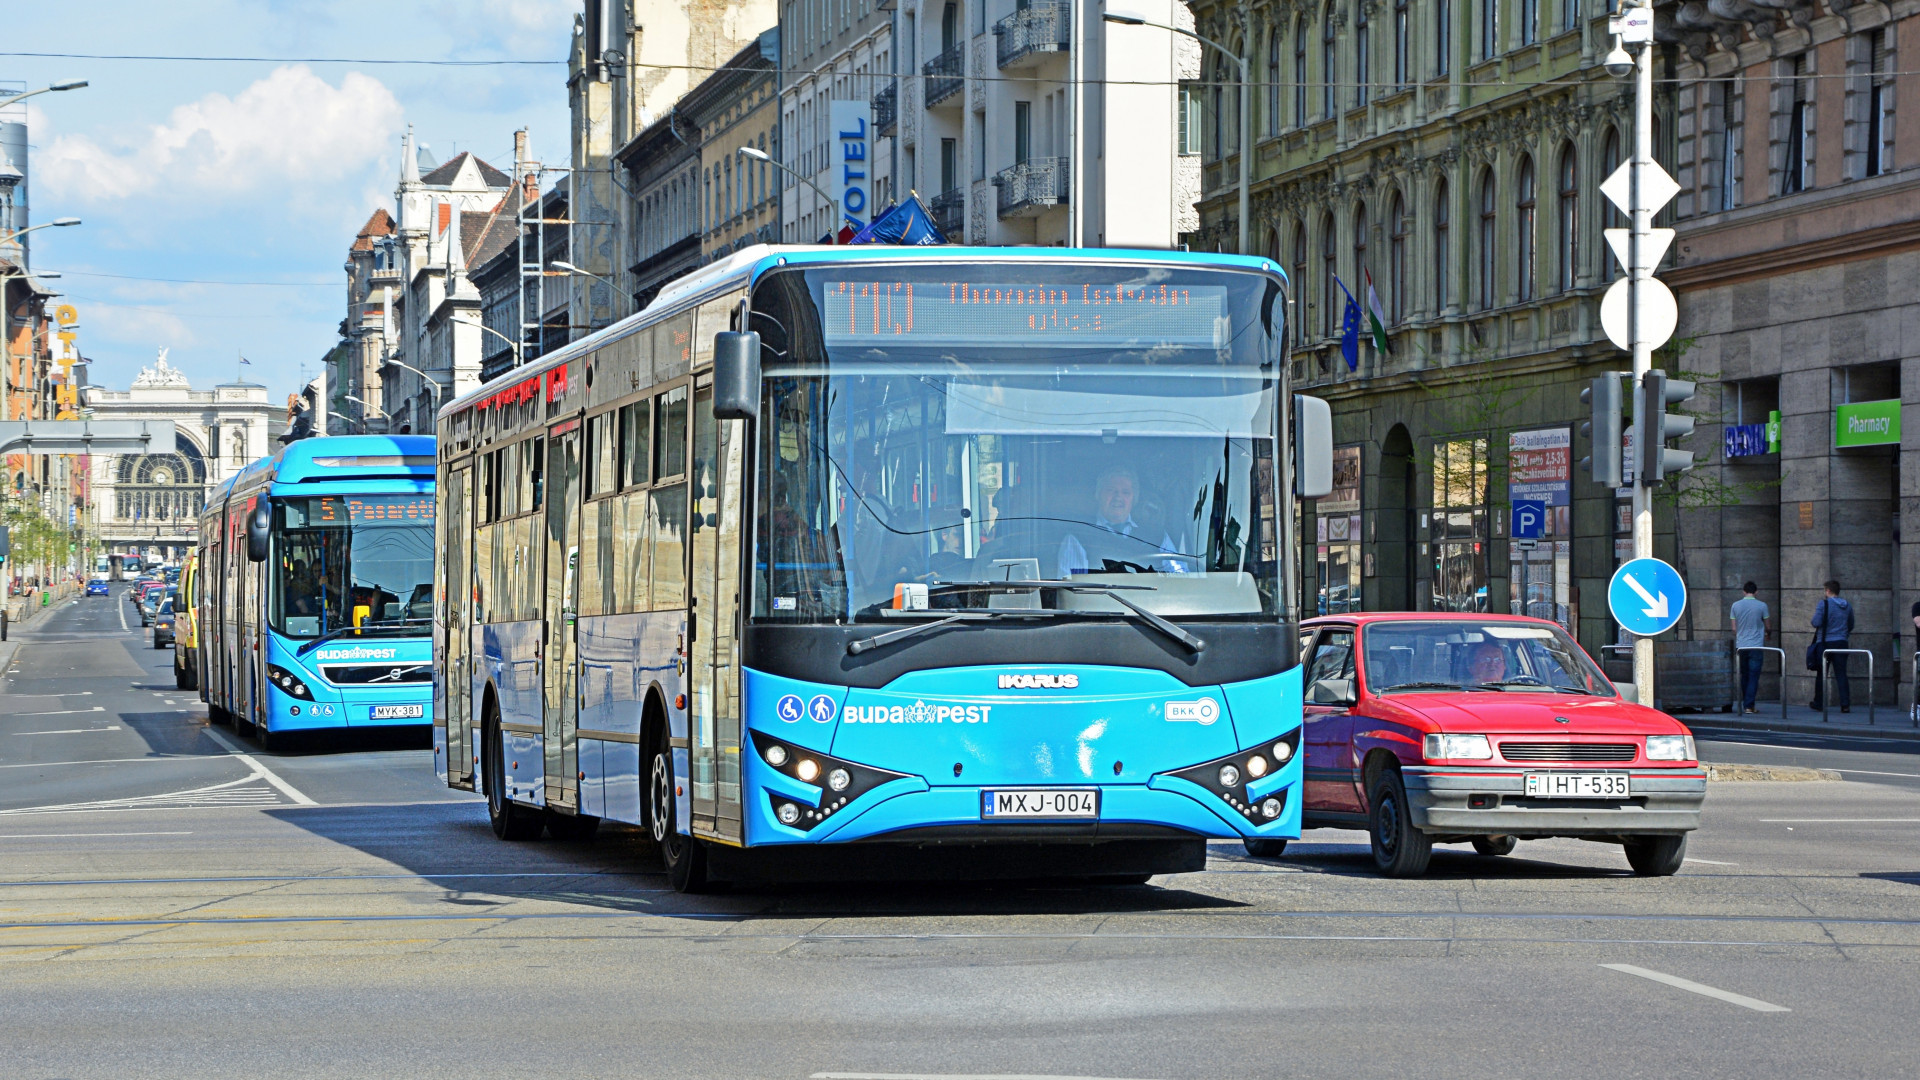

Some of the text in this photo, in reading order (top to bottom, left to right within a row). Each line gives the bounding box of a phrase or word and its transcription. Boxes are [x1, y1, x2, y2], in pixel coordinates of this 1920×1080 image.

[1848, 415, 1891, 434] Pharmacy
[1520, 513, 1536, 534] P
[997, 674, 1080, 690] IKARUS
[377, 706, 420, 717] MYK-381
[1172, 707, 1195, 716] BKK
[1547, 776, 1626, 794] IHT-535
[998, 793, 1092, 813] MXJ-004
